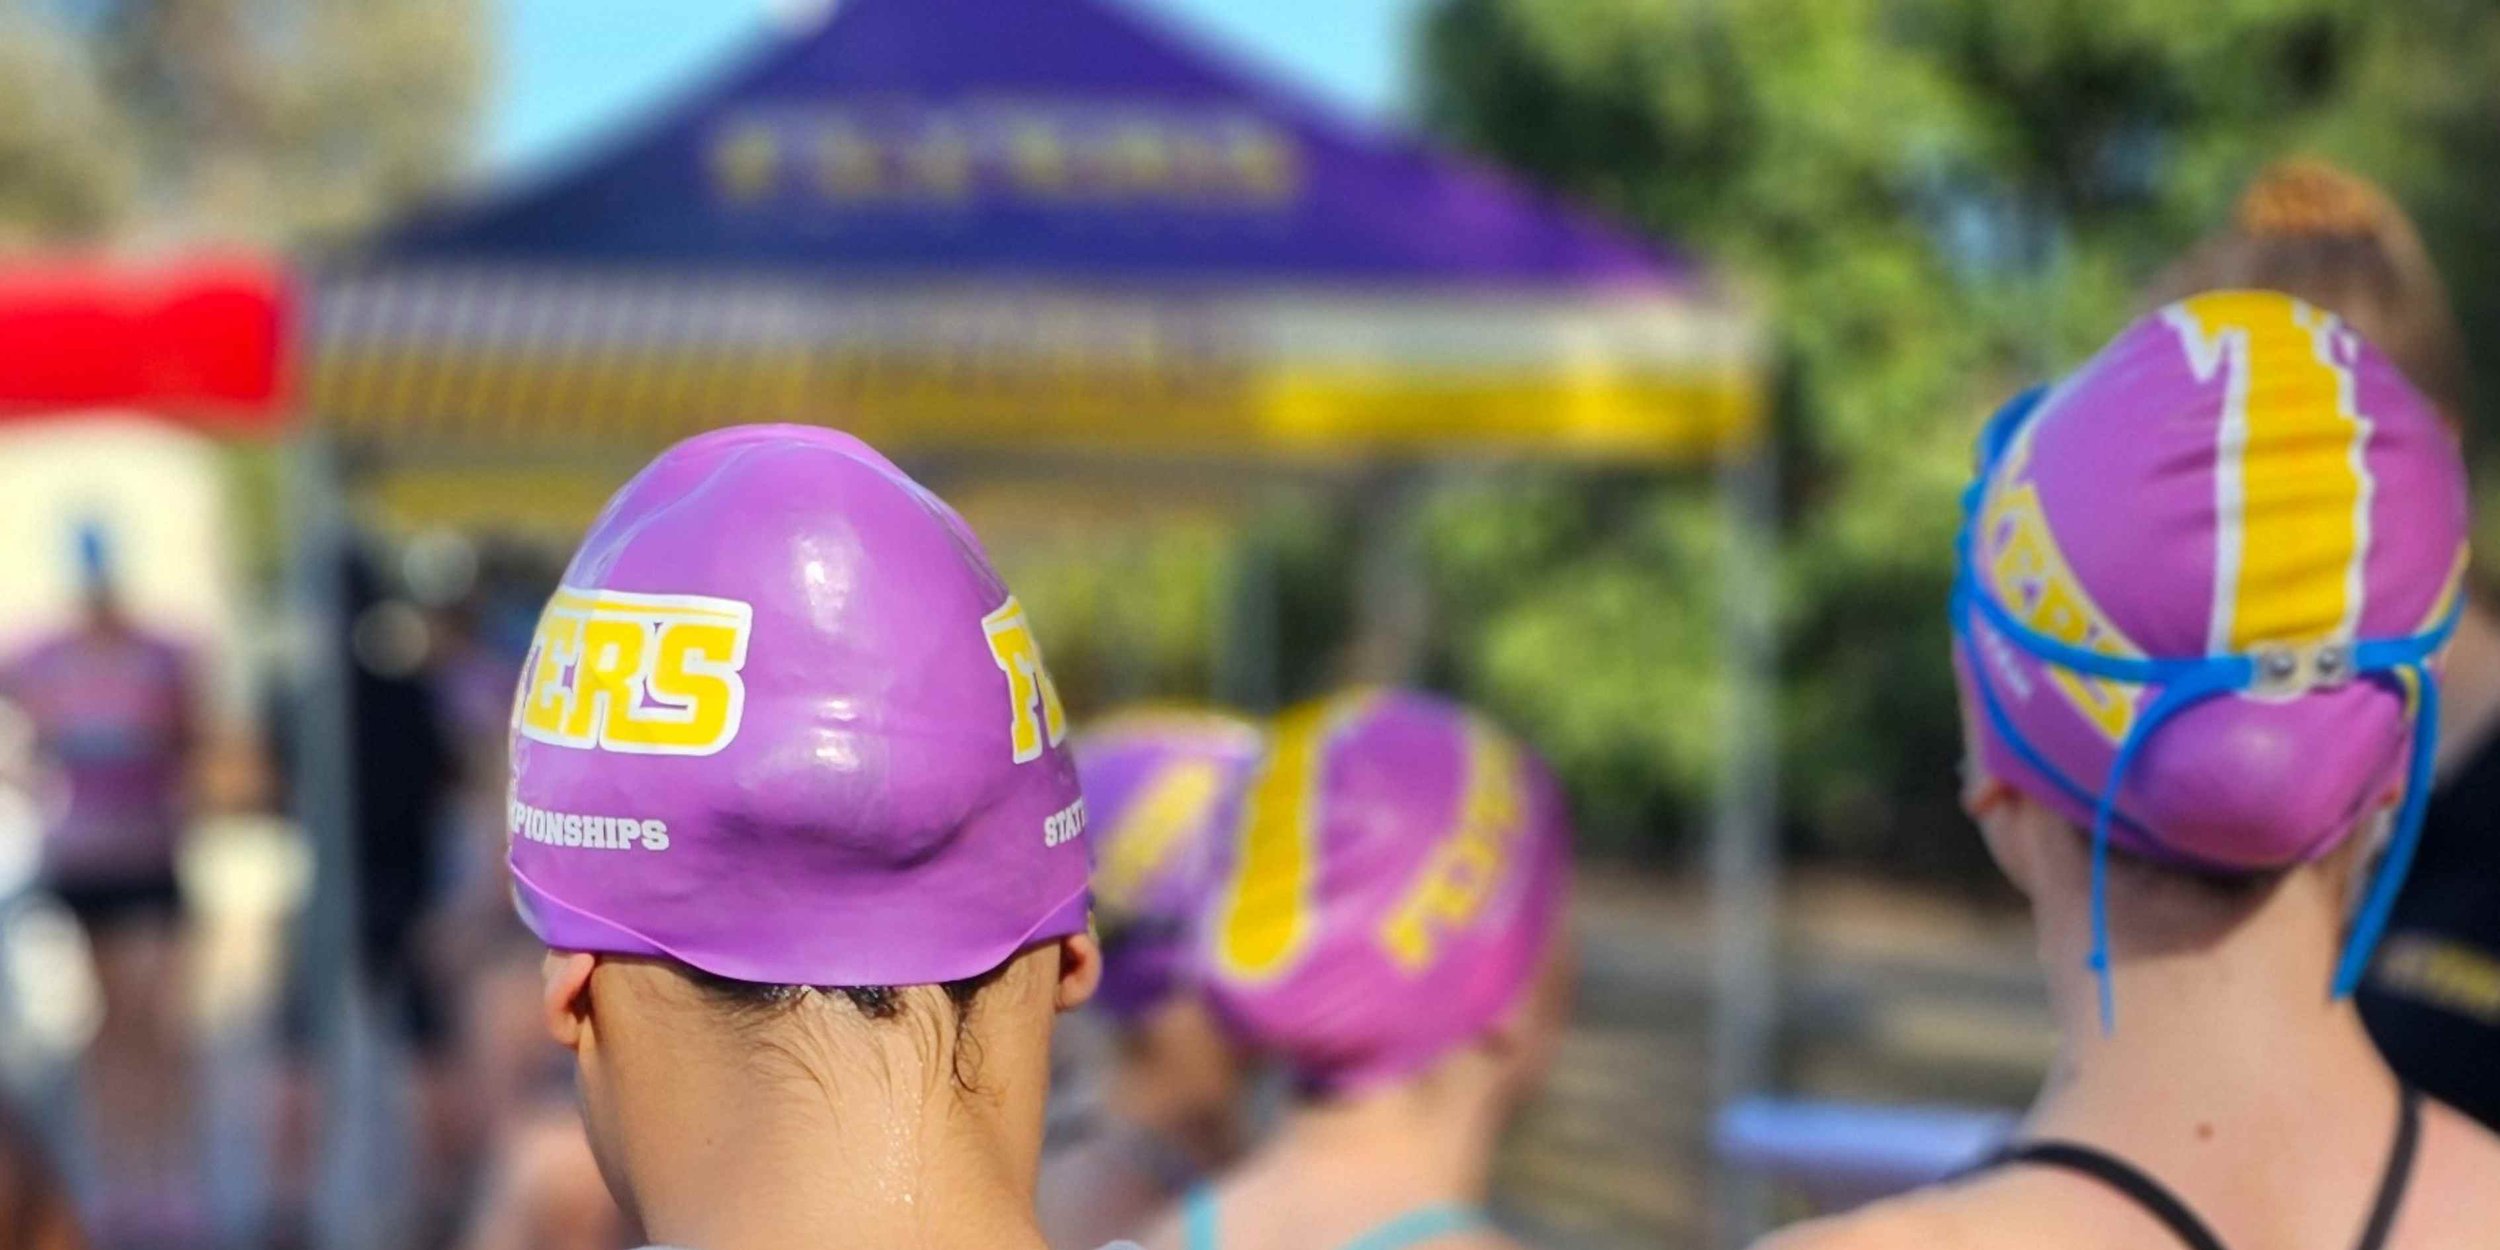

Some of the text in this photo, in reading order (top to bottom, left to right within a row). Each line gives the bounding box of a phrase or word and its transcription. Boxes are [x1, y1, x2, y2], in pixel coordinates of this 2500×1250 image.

[514, 590, 752, 756] ERS
[511, 800, 670, 850] PIONSHIPS
[1044, 796, 1087, 848] STAT
